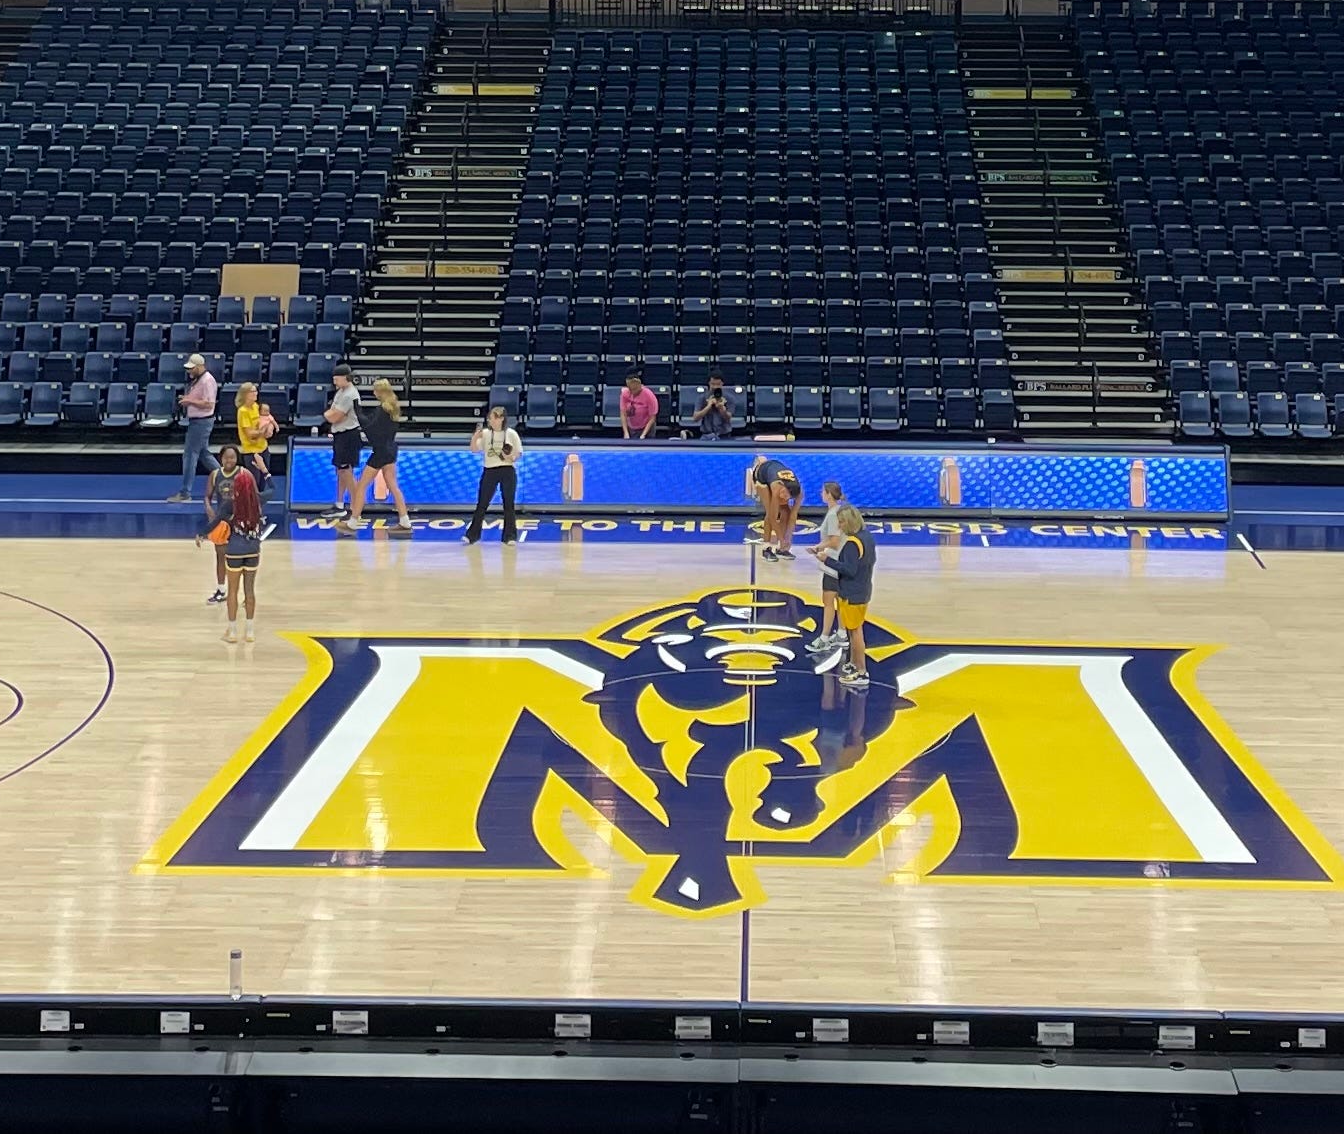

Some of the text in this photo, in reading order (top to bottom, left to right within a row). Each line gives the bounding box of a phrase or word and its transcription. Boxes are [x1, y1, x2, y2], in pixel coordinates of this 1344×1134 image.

[988, 173, 1005, 182] BPS
[1026, 382, 1047, 391] BPS
[560, 519, 619, 534] TO
[643, 520, 726, 534] THE
[1030, 524, 1225, 540] CENTER
